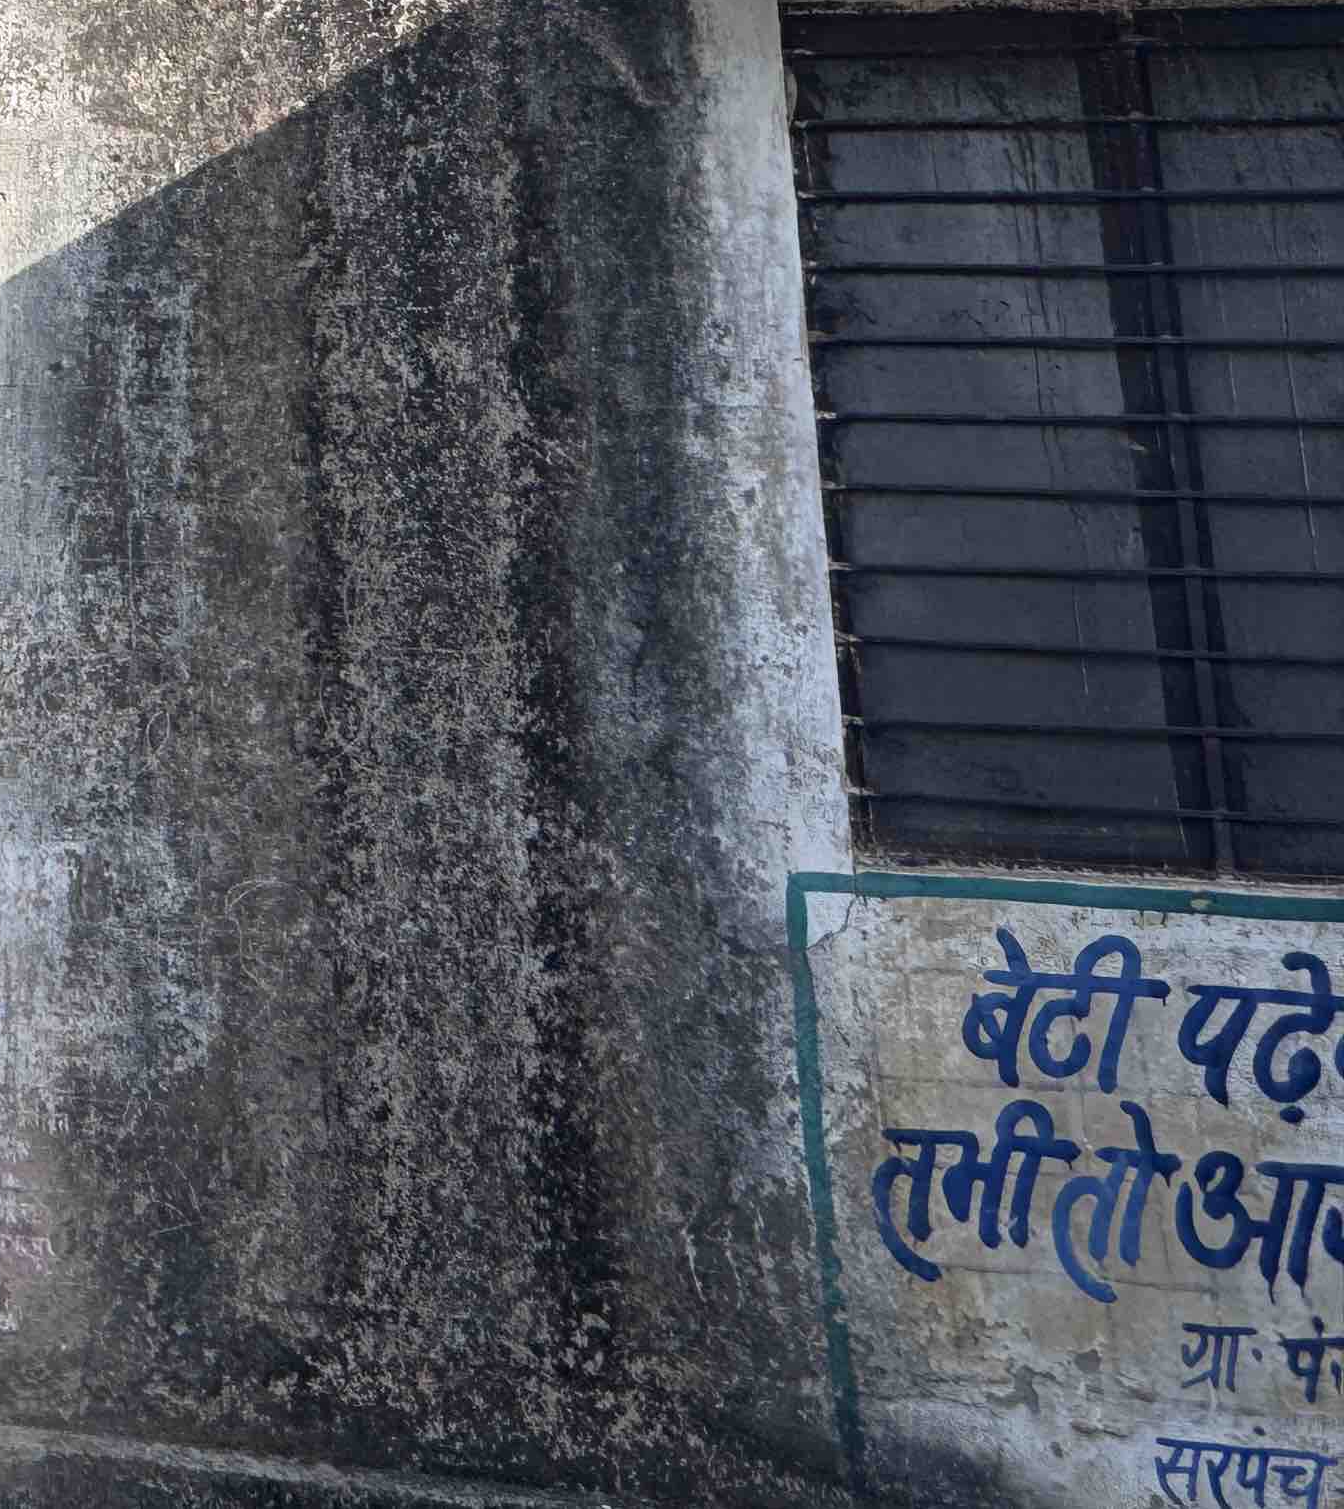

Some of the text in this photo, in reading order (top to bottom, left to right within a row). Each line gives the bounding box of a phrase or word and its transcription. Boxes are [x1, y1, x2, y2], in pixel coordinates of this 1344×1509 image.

[962, 927, 1172, 1095] बेटी
[872, 1099, 1082, 1283] तभी
[1051, 1100, 1182, 1304] तो
[1154, 1425, 1340, 1509] सरपंच
